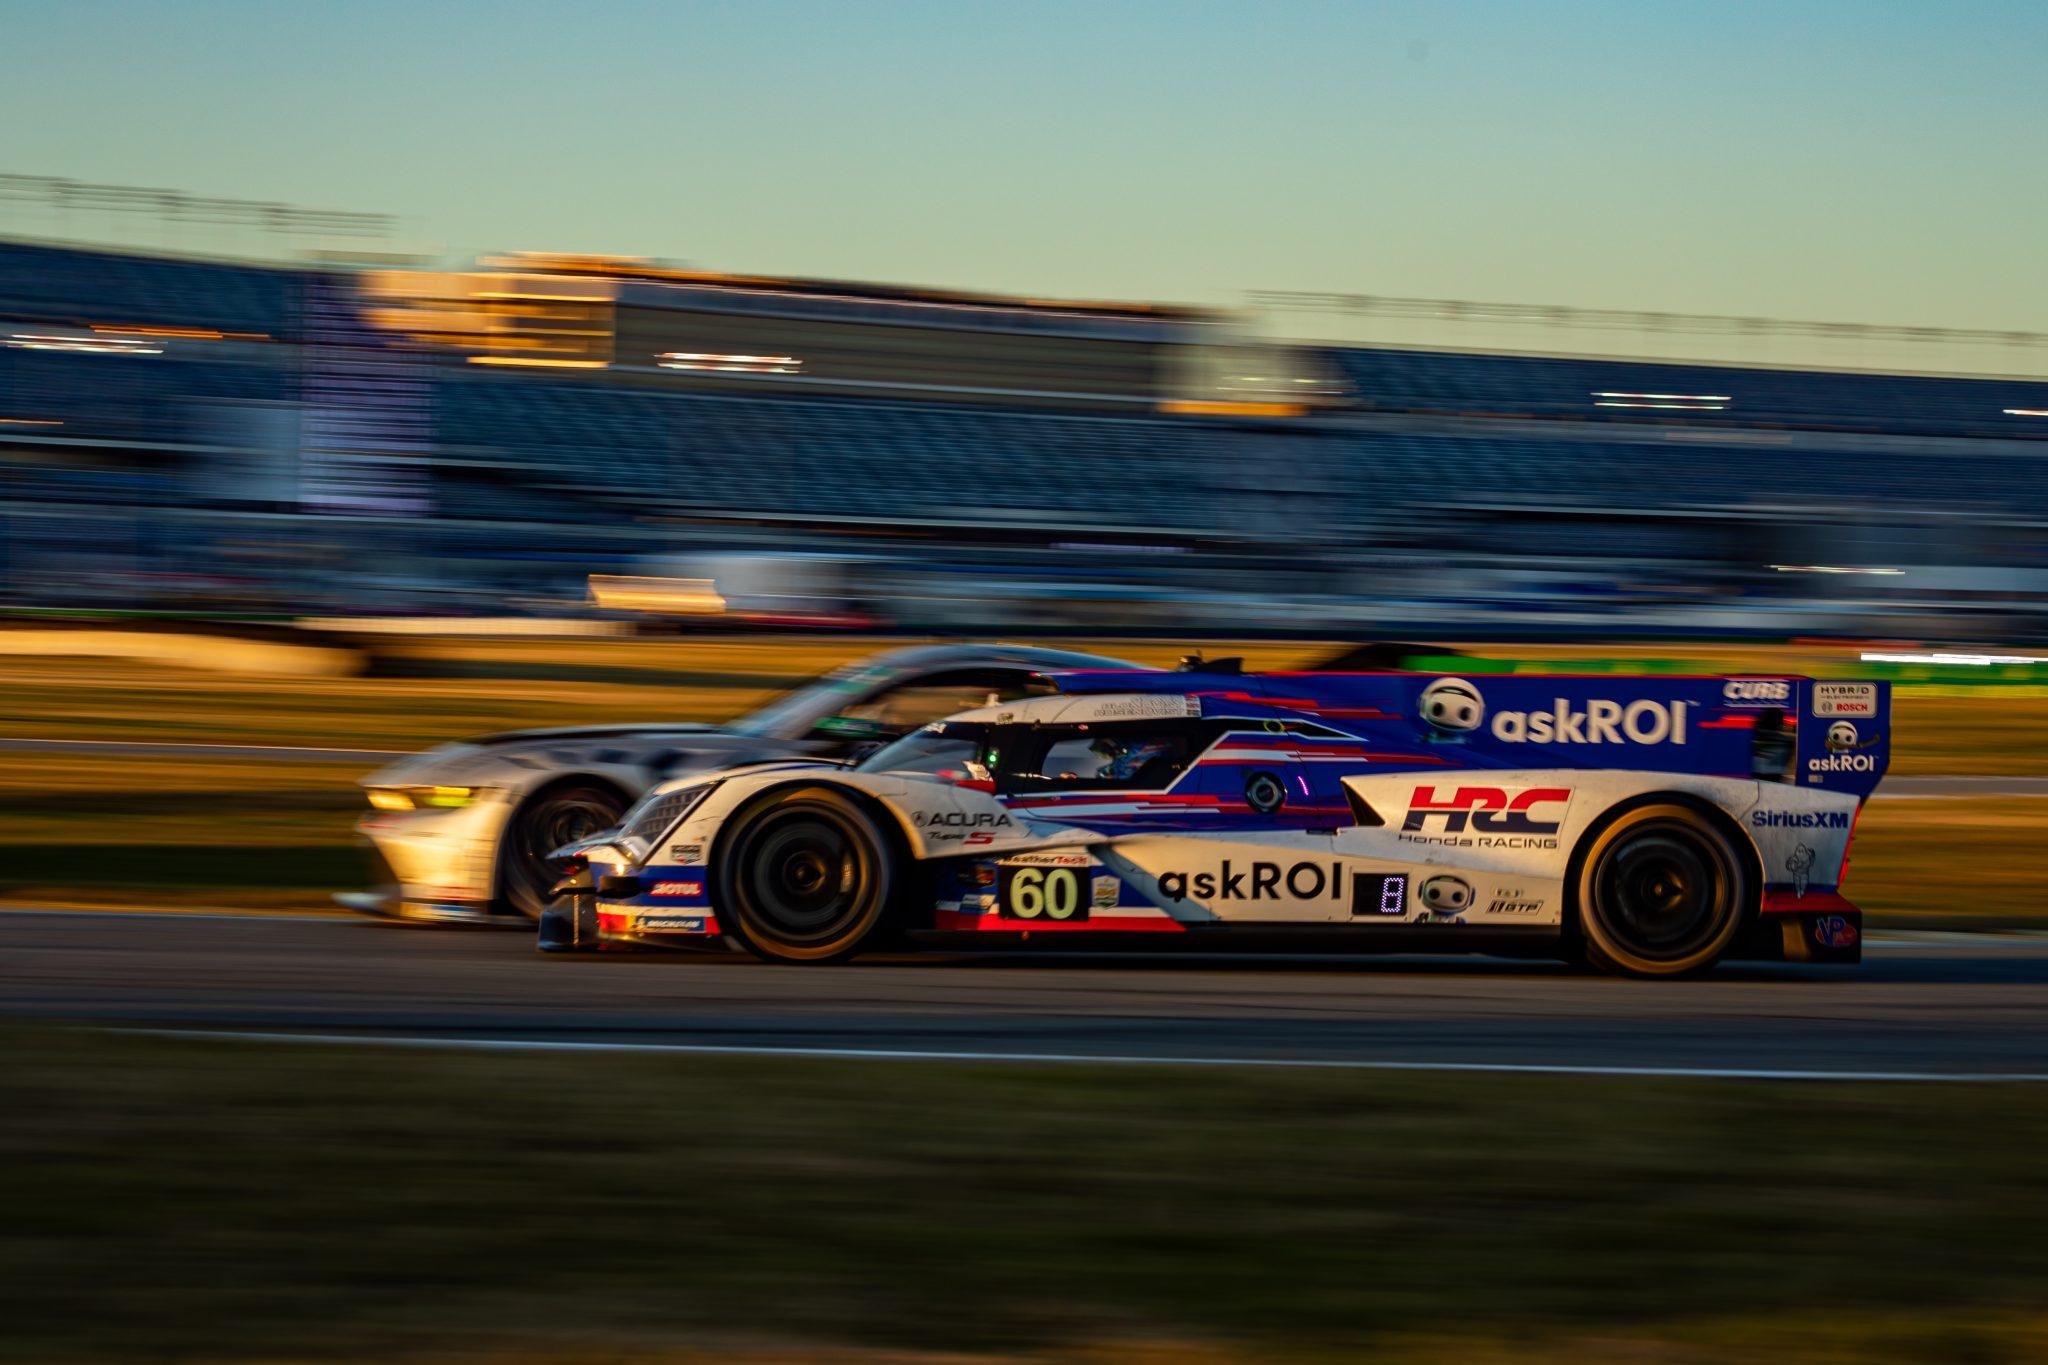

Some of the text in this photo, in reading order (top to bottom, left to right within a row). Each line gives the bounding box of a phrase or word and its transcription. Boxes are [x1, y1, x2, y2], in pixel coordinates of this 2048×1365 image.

[1820, 686, 1870, 694] HYBRID
[1836, 703, 1868, 711] BOSCH
[1491, 698, 1687, 744] askROI
[1808, 754, 1875, 772] askROI
[1401, 786, 1571, 834] HRC
[1752, 810, 1849, 828] SiriusXM
[927, 813, 1013, 827] ACURA
[963, 832, 996, 844] S
[1399, 834, 1557, 849] Honda RACING
[1158, 859, 1342, 901] askROI
[1010, 868, 1078, 919] 60
[1381, 877, 1404, 913] 8
[1816, 915, 1847, 946] VP
